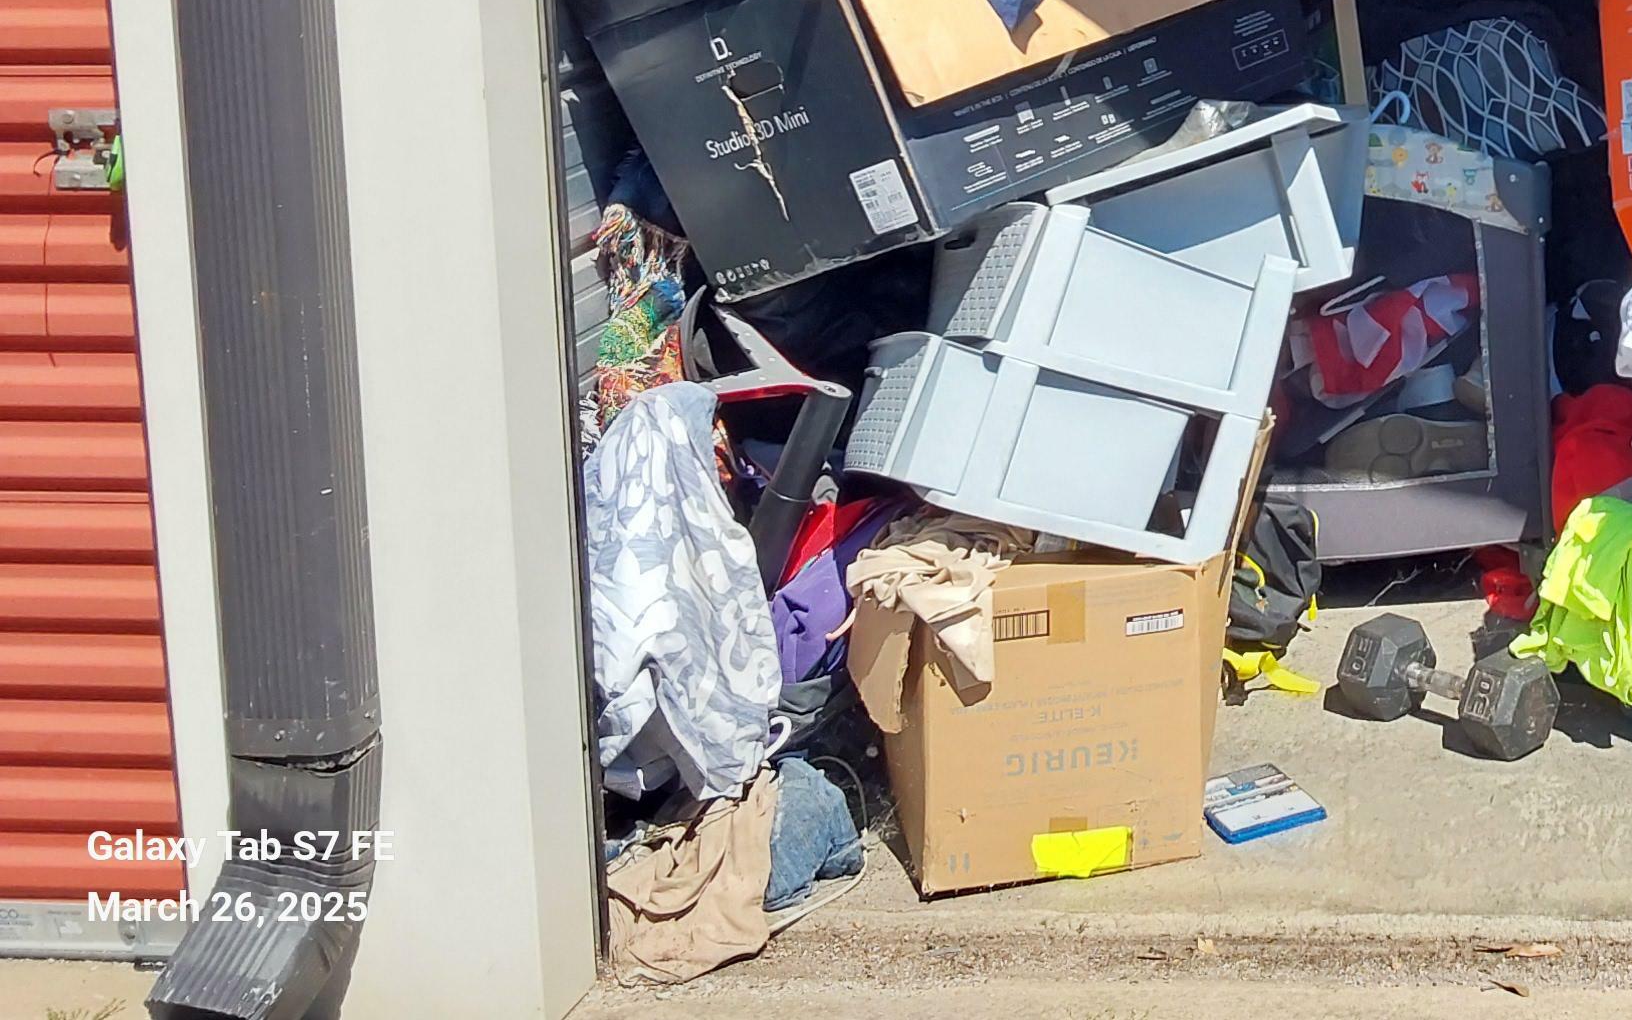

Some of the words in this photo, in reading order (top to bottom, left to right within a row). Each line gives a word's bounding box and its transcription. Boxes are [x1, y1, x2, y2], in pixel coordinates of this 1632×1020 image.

[705, 129, 752, 159] Studio
[754, 120, 775, 141] 3D
[773, 106, 810, 133] Mini
[1004, 738, 1139, 778] KEURIG
